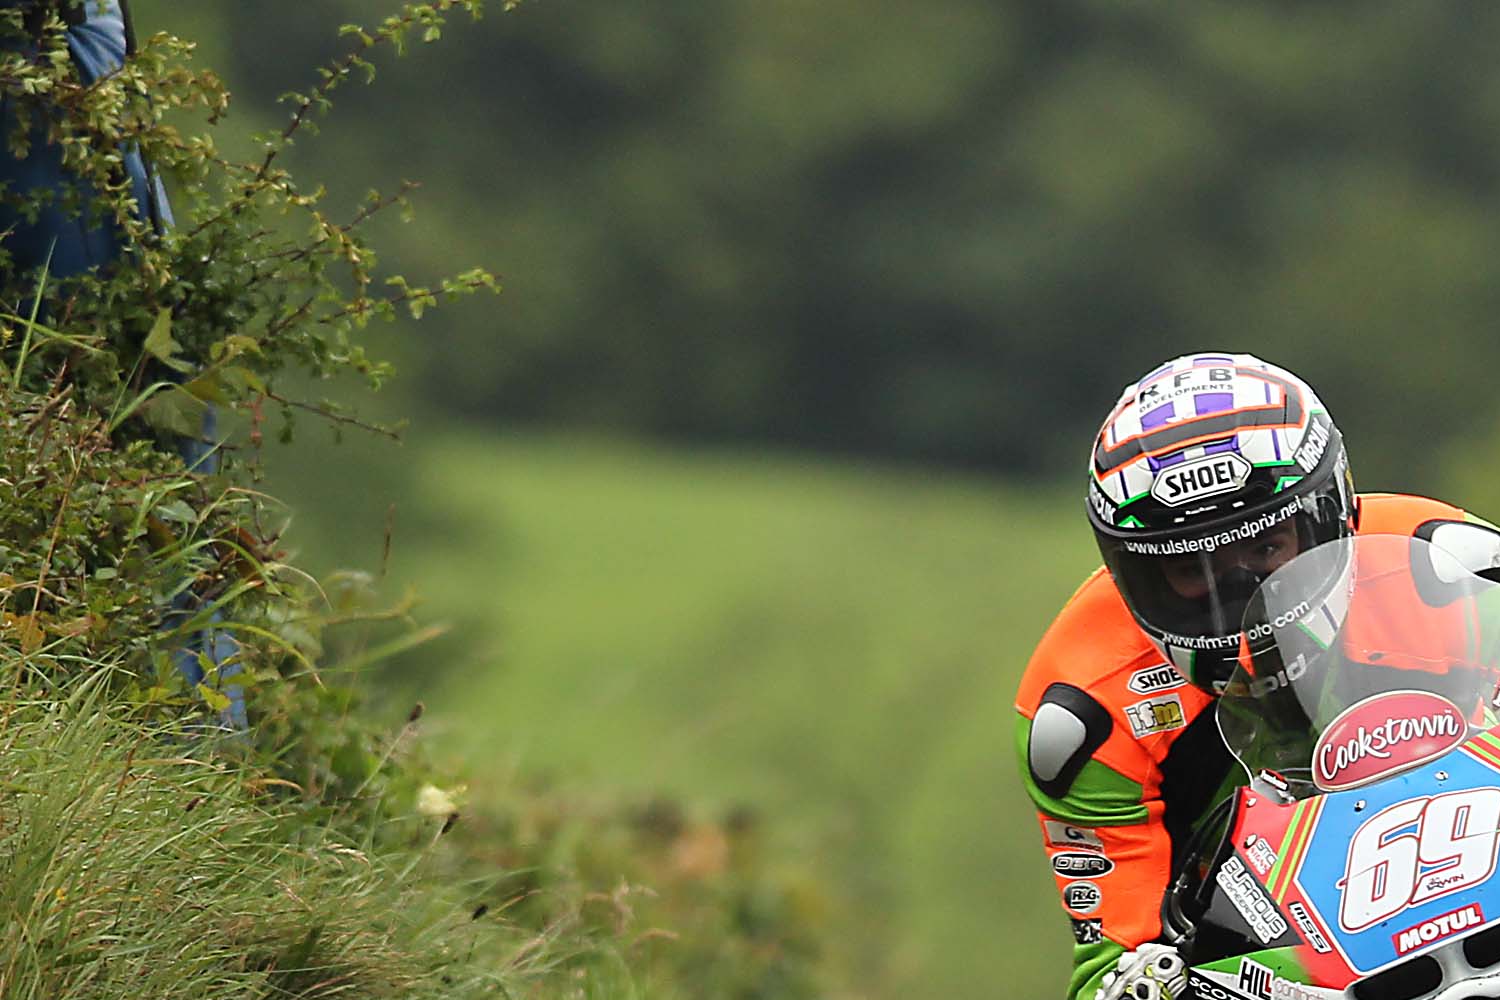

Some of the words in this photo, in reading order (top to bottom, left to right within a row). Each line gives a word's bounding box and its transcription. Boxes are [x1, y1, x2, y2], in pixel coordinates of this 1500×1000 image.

[1139, 384, 1233, 413] DEVELOPMENTS
[1165, 460, 1236, 498] SHOEI
[1125, 496, 1303, 555] www.ulstergrandprix.net
[1138, 668, 1183, 689] SHOE
[1320, 710, 1458, 780] Cookstown
[1400, 907, 1481, 952] MOTUL
